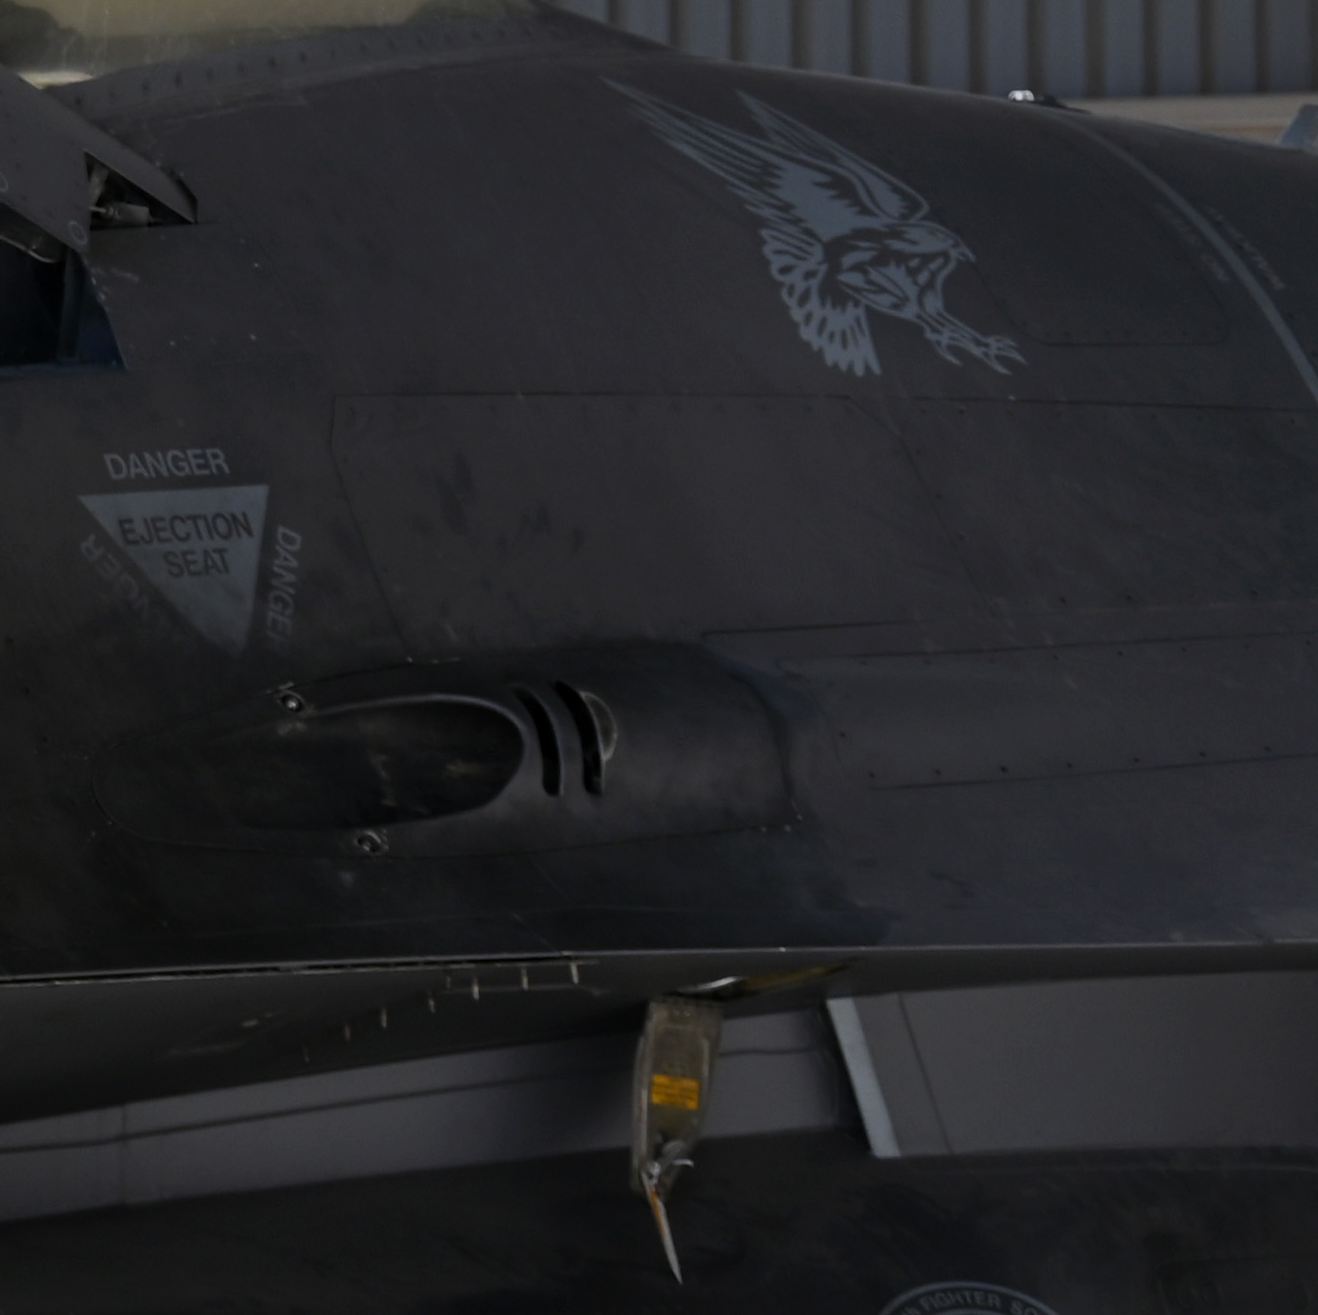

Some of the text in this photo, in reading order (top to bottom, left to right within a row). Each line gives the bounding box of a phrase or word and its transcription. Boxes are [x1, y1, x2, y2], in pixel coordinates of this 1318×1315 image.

[103, 448, 231, 480] DANGER
[118, 511, 255, 546] EJECTION
[163, 548, 232, 578] SEAT
[919, 1290, 1003, 1311] FIGHTER
